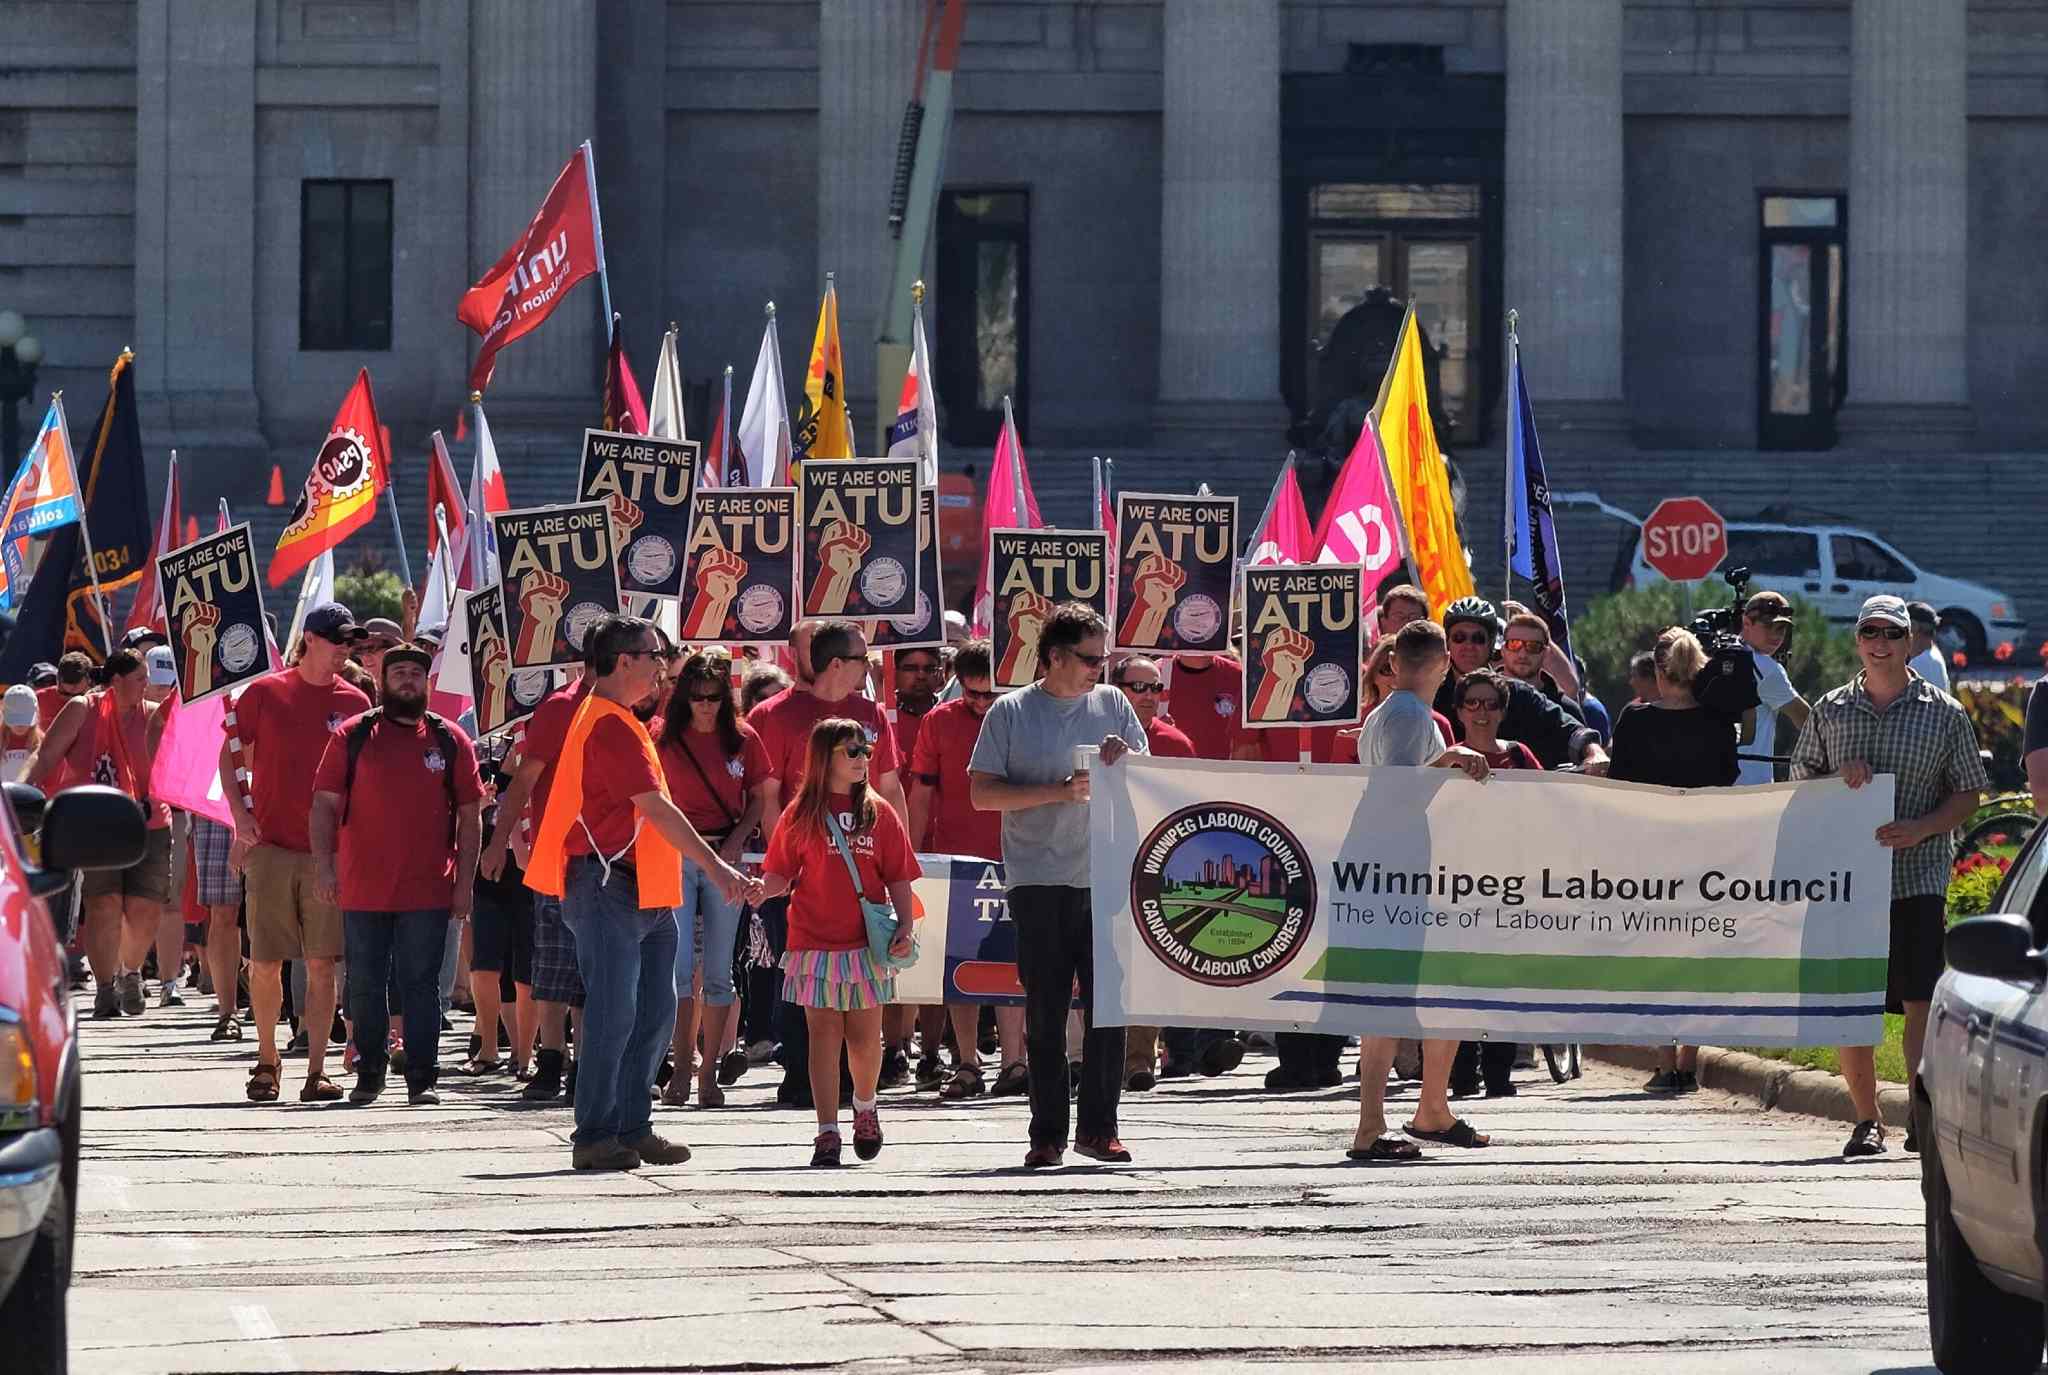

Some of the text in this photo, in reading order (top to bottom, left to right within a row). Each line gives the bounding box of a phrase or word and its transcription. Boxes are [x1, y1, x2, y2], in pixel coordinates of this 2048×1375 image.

[593, 441, 692, 466] WE ARE ONE
[586, 459, 690, 506] ATU
[809, 469, 912, 486] WE ARE ONE
[501, 513, 604, 537] WE ARE ONE
[719, 499, 751, 513] ARE
[754, 499, 789, 513] ONE
[809, 486, 912, 527] ATU
[1128, 505, 1229, 523] WE ARE ONE
[507, 530, 608, 579] ATU
[688, 515, 789, 554] ATU
[1000, 540, 1100, 557] WE ARE ONE
[1125, 522, 1229, 564] ATU
[1648, 522, 1721, 558] STOP
[164, 535, 247, 579] WE ARE ONE
[171, 551, 250, 617] ATU
[1000, 557, 1100, 599] ATU
[1252, 575, 1355, 592] WE ARE ONE
[470, 601, 491, 617] WE
[1252, 591, 1355, 634] ATU
[1143, 812, 1304, 885] WINNIPEG LABOUR COUNCIL
[1332, 861, 1852, 906] Winnipeg Labour Council
[1142, 898, 1304, 977] CANADIAN LABOUR CONGRESS
[1332, 902, 1737, 938] The Voice of Labour in Winnipeg
